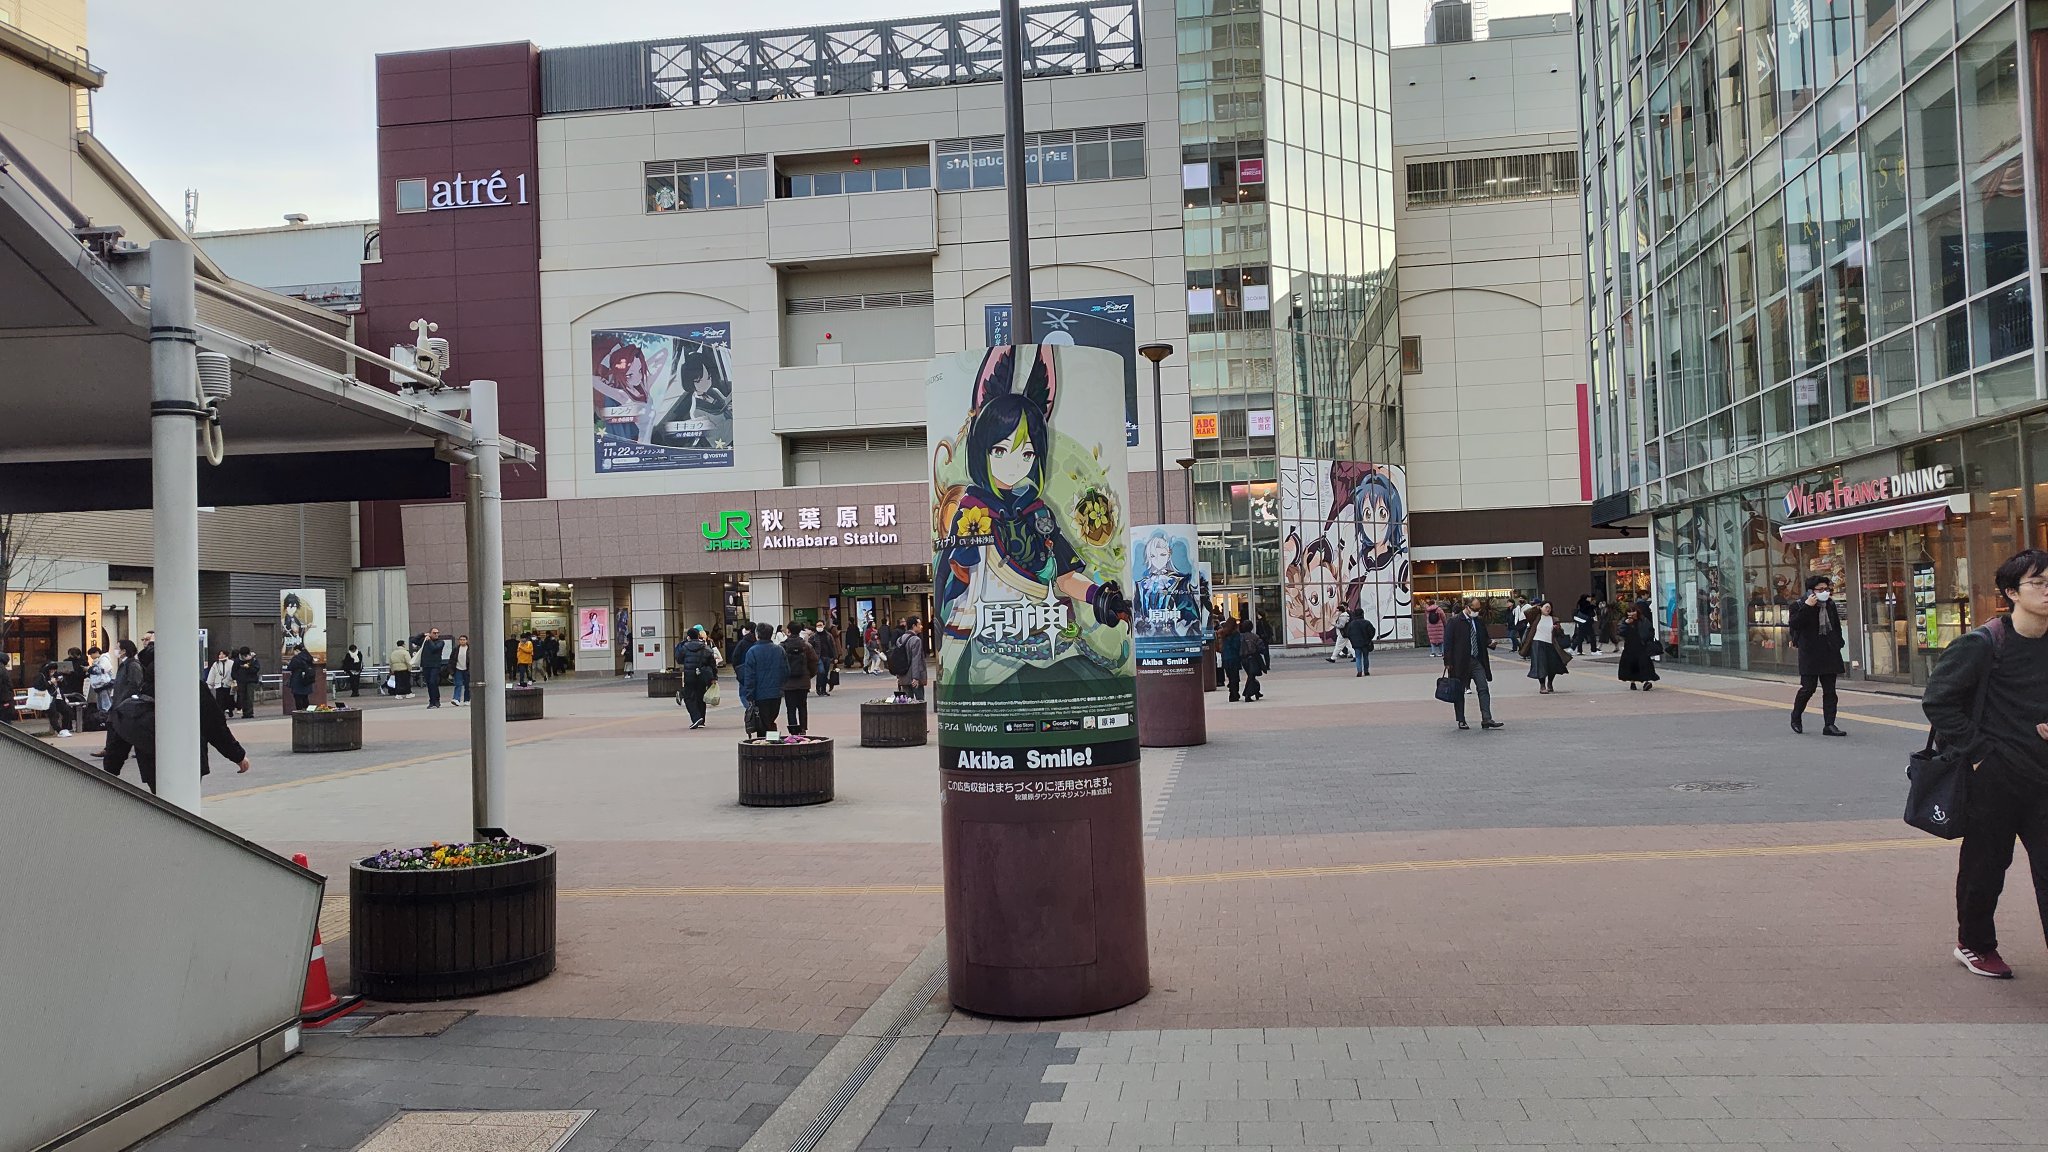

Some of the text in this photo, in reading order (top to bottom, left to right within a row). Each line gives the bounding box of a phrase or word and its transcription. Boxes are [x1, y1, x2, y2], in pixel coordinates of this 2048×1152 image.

[946, 156, 1004, 170] STARBUC
[432, 169, 507, 207] atré
[1196, 418, 1215, 428] ABC
[1793, 464, 1946, 516] VIE DE FRANCE DINING
[701, 509, 752, 539] JR
[761, 504, 897, 532] 秋葉原駅
[704, 539, 752, 550] JR東日本
[762, 531, 898, 549] Akihabara Station
[1551, 544, 1576, 555] atré
[972, 580, 1069, 661] 原神
[1148, 602, 1181, 630] 原神
[981, 644, 1038, 654] Genshin
[944, 723, 960, 731] PS4
[964, 722, 998, 732] Windows
[1052, 720, 1069, 728] Google
[1069, 719, 1079, 727] Play
[957, 747, 1093, 770] Akiba Smile!
[947, 776, 1113, 794] この広告収益はまちづくりに活用されます。
